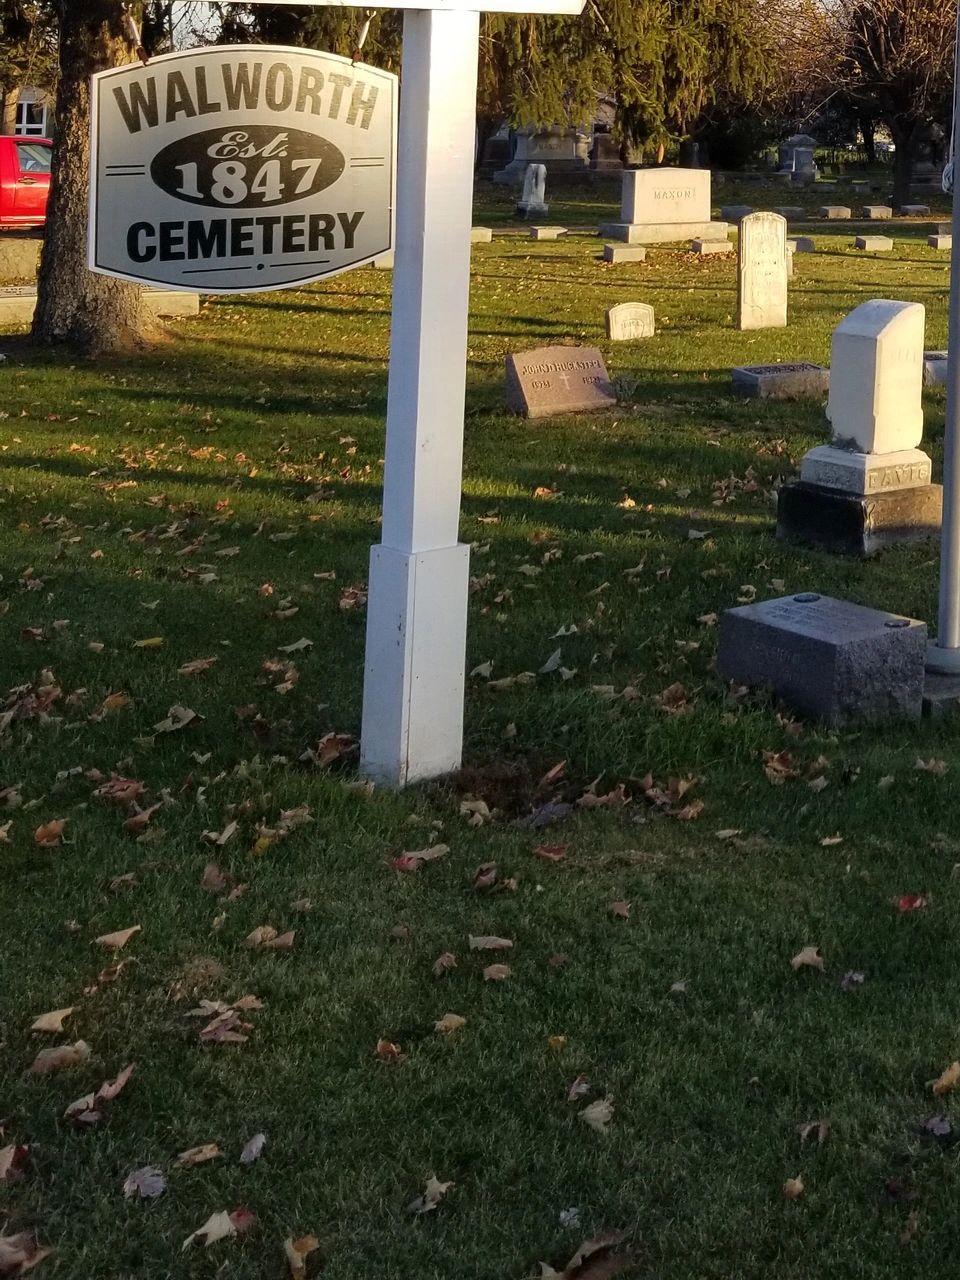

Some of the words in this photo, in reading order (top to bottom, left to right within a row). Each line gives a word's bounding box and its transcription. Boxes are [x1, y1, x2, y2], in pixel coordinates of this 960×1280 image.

[111, 62, 380, 134] WALWORTH
[207, 131, 288, 159] Est.
[174, 158, 322, 205] 1847
[653, 189, 691, 201] MAXON
[126, 211, 366, 263] CEMETERY
